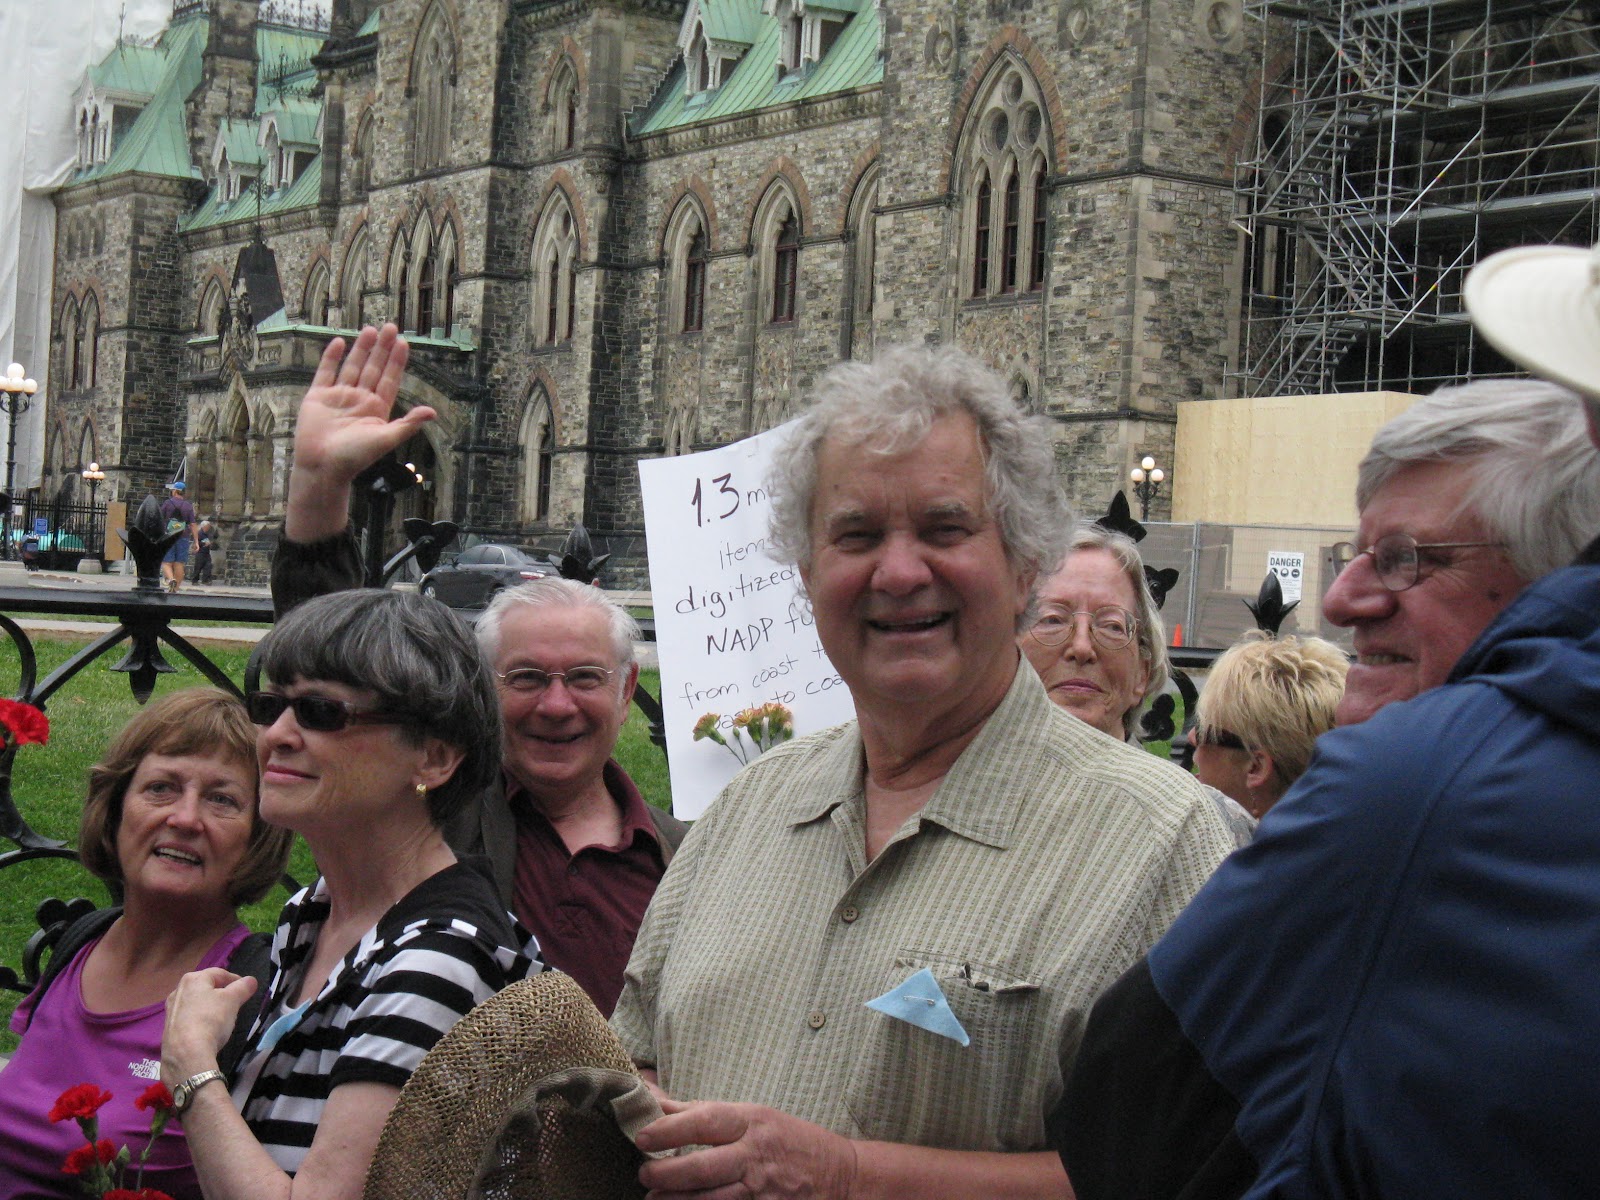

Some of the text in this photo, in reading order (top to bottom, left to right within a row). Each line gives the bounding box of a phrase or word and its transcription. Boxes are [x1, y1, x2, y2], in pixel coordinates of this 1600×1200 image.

[691, 472, 740, 528] 1.3
[1270, 557, 1302, 567] DANGER
[675, 563, 796, 618] digitized
[706, 617, 774, 655] NADP
[679, 682, 740, 710] from
[752, 653, 799, 689] coast
[770, 691, 796, 706] to
[128, 1062, 152, 1073] NORTH
[142, 1058, 157, 1067] THE
[132, 1070, 150, 1079] FACE
